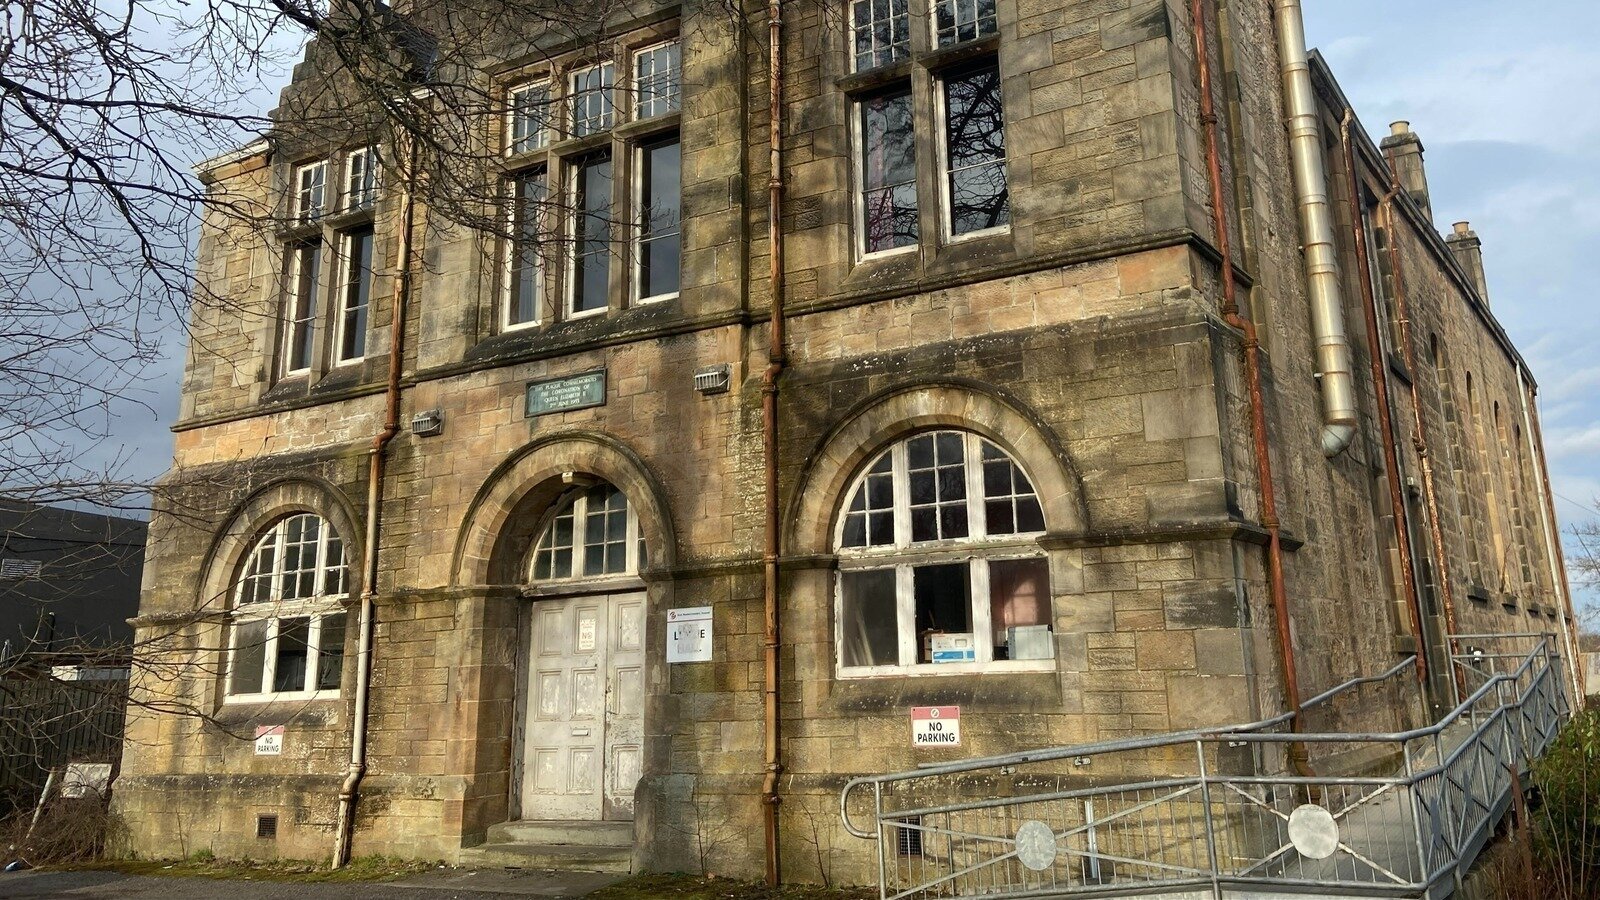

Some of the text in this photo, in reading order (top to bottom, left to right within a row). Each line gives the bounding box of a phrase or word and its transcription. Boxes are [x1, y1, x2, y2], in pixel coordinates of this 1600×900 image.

[551, 386, 581, 396] CORONATION
[544, 395, 559, 403] QUEEN
[560, 392, 581, 401] ELIZABETH
[929, 722, 943, 731] NO
[917, 733, 955, 742] PARKING
